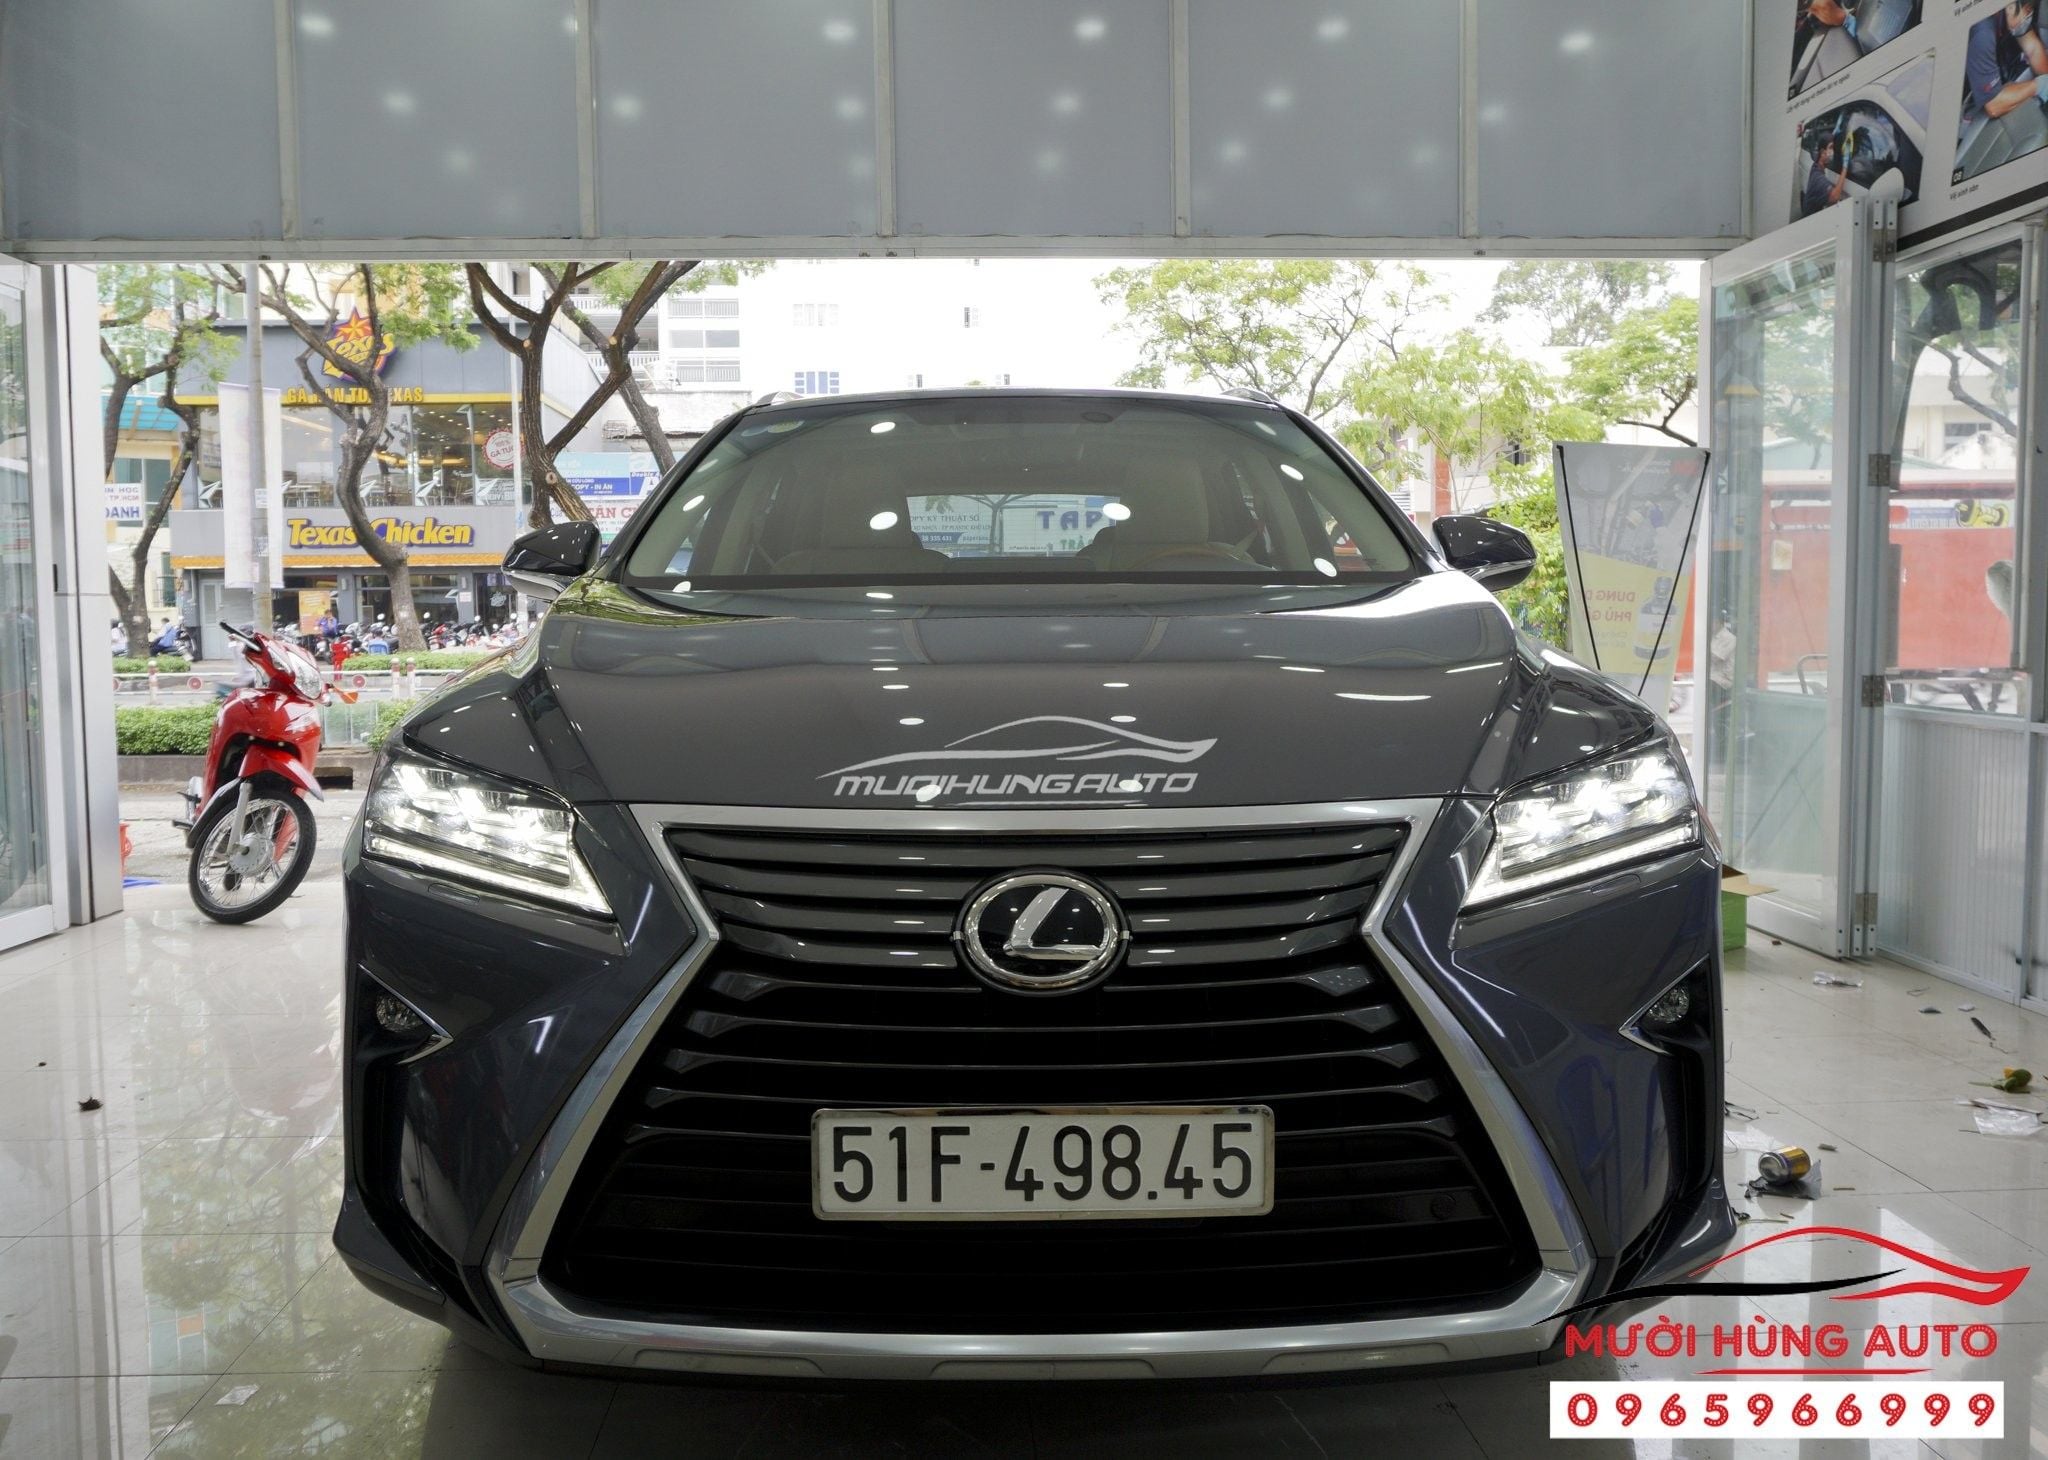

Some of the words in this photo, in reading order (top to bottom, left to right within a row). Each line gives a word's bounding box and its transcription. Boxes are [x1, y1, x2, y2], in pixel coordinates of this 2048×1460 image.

[287, 518, 358, 548] Texas
[369, 517, 475, 548] Chicken
[832, 1122, 1253, 1203] 51F-498.45
